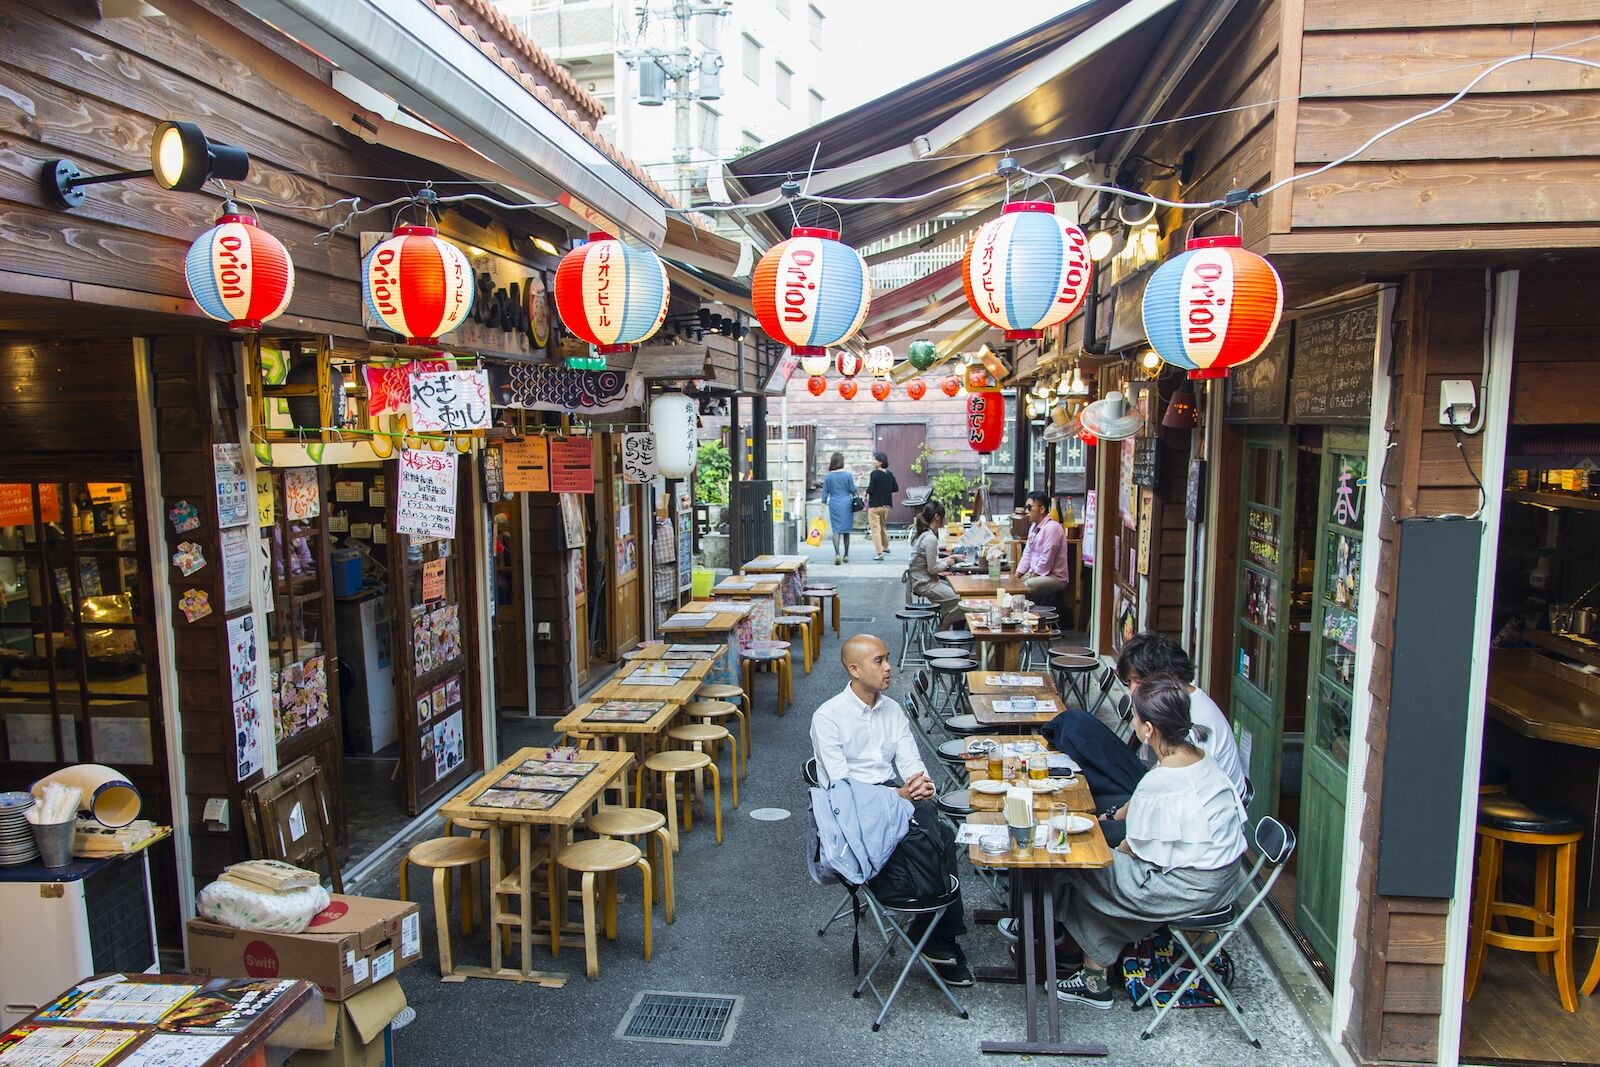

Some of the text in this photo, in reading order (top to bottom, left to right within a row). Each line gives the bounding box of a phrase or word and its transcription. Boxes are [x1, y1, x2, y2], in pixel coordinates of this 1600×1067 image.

[219, 235, 248, 299] Orion
[374, 249, 397, 315] Orion
[598, 244, 611, 327] オリオンビール
[784, 250, 816, 323] Orion
[982, 221, 1004, 314] オリオンビール
[1058, 227, 1088, 304] Orion
[1188, 263, 1226, 344] Orion
[412, 374, 457, 409] やぎ
[441, 404, 486, 431] 刺し
[970, 396, 985, 443] おでん
[402, 451, 446, 471] 梅酒
[245, 954, 277, 970] Swift
